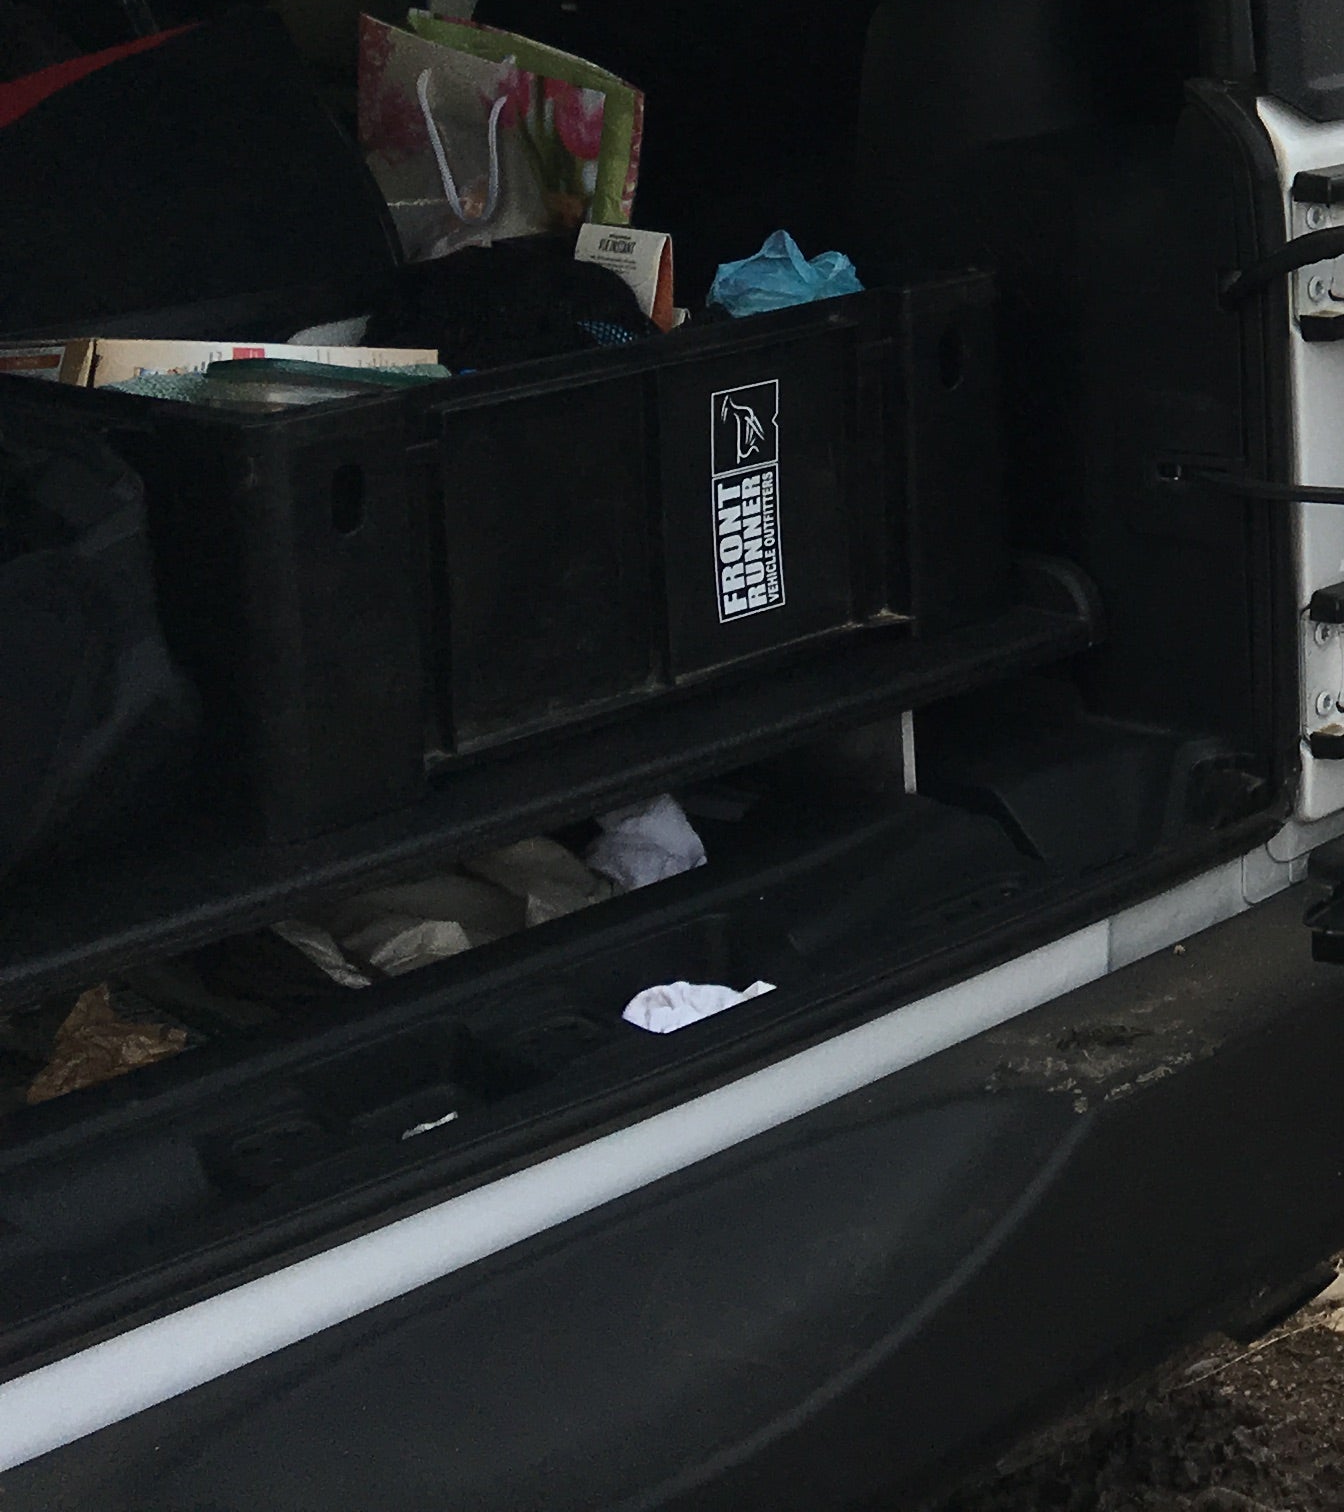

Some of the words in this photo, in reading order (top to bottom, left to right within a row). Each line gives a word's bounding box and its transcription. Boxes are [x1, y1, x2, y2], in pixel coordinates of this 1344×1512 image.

[718, 484, 747, 616] FRONT
[741, 474, 768, 609] RUNNER
[761, 471, 775, 547] OUTFITTERS
[764, 548, 780, 603] VEHICLE
